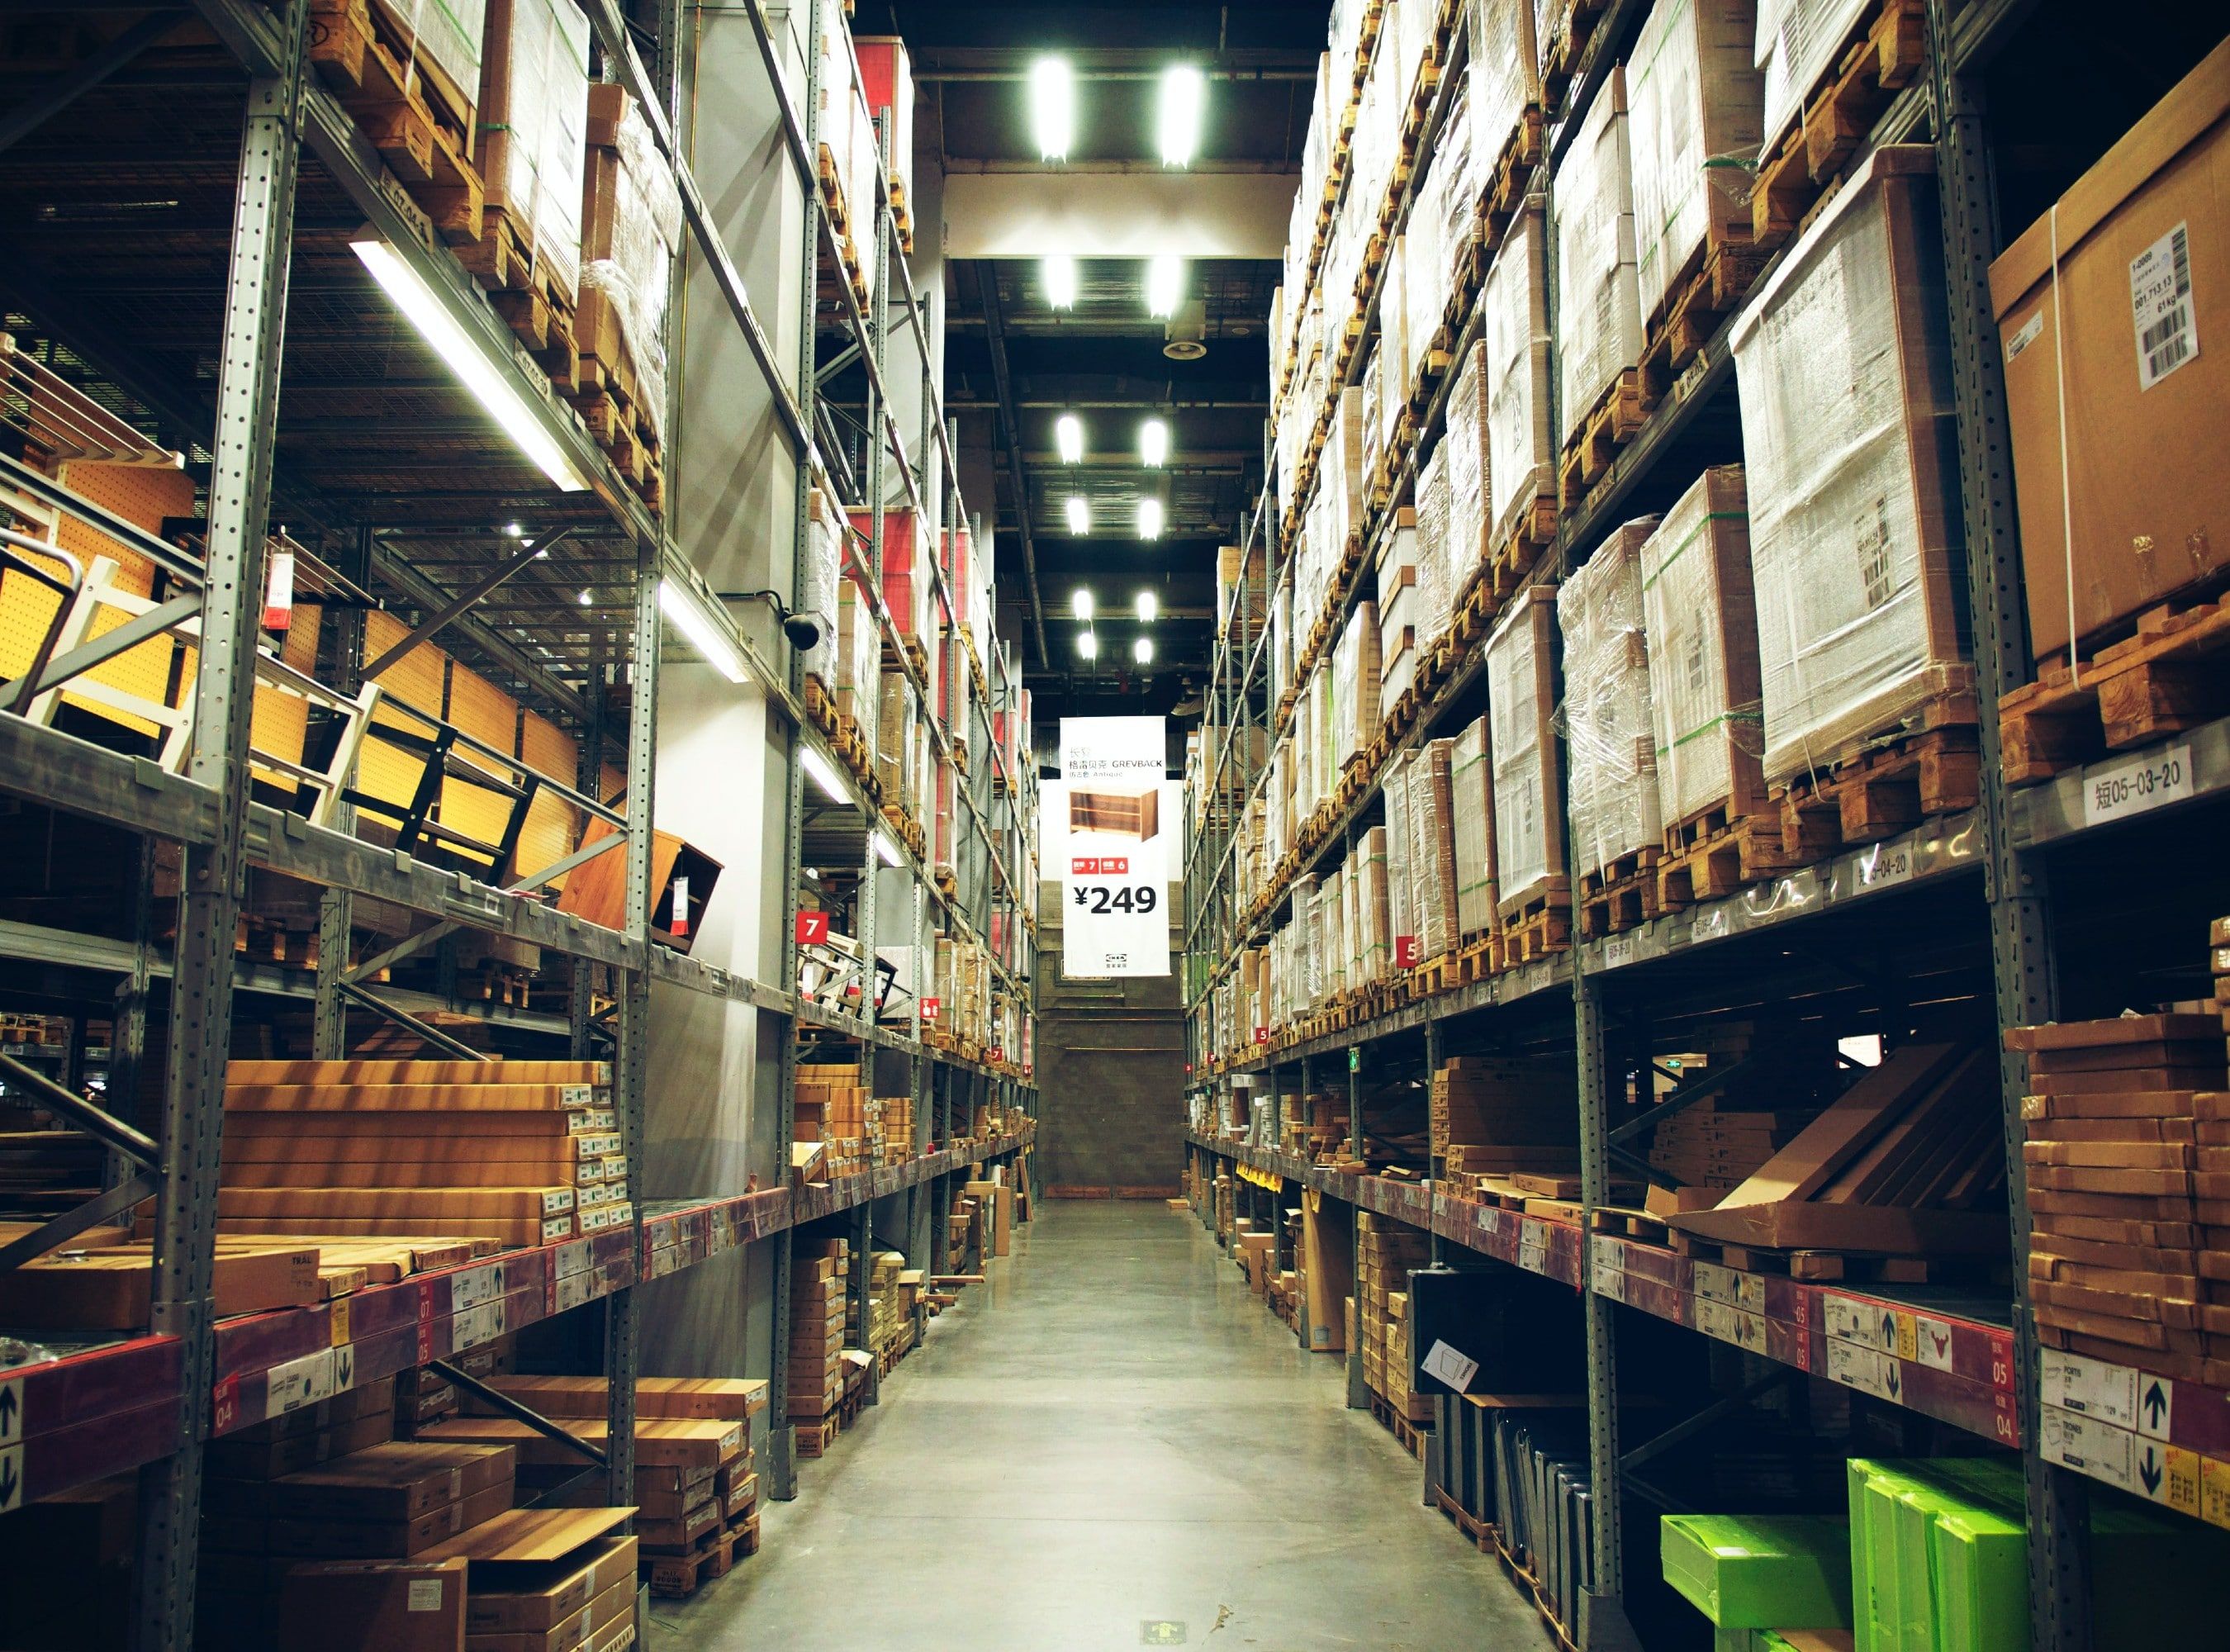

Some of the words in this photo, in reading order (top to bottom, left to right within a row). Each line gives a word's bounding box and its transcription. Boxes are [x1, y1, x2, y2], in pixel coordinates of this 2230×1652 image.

[2134, 275, 2172, 311] 001.713.13
[2095, 760, 2180, 810] 短05-03-20
[1089, 861, 1096, 871] 7
[1117, 861, 1126, 870] 6
[1073, 885, 1157, 914] ¥249
[805, 918, 820, 937] 7
[1406, 942, 1416, 961] 5
[1260, 1030, 1267, 1040] 5
[420, 1300, 430, 1318] 07
[1796, 1306, 1805, 1324] 05
[419, 1343, 429, 1361] 05
[1796, 1348, 1805, 1365] 05
[1993, 1360, 2007, 1385] 05
[216, 1401, 233, 1429] 04
[1996, 1414, 2012, 1438] 04
